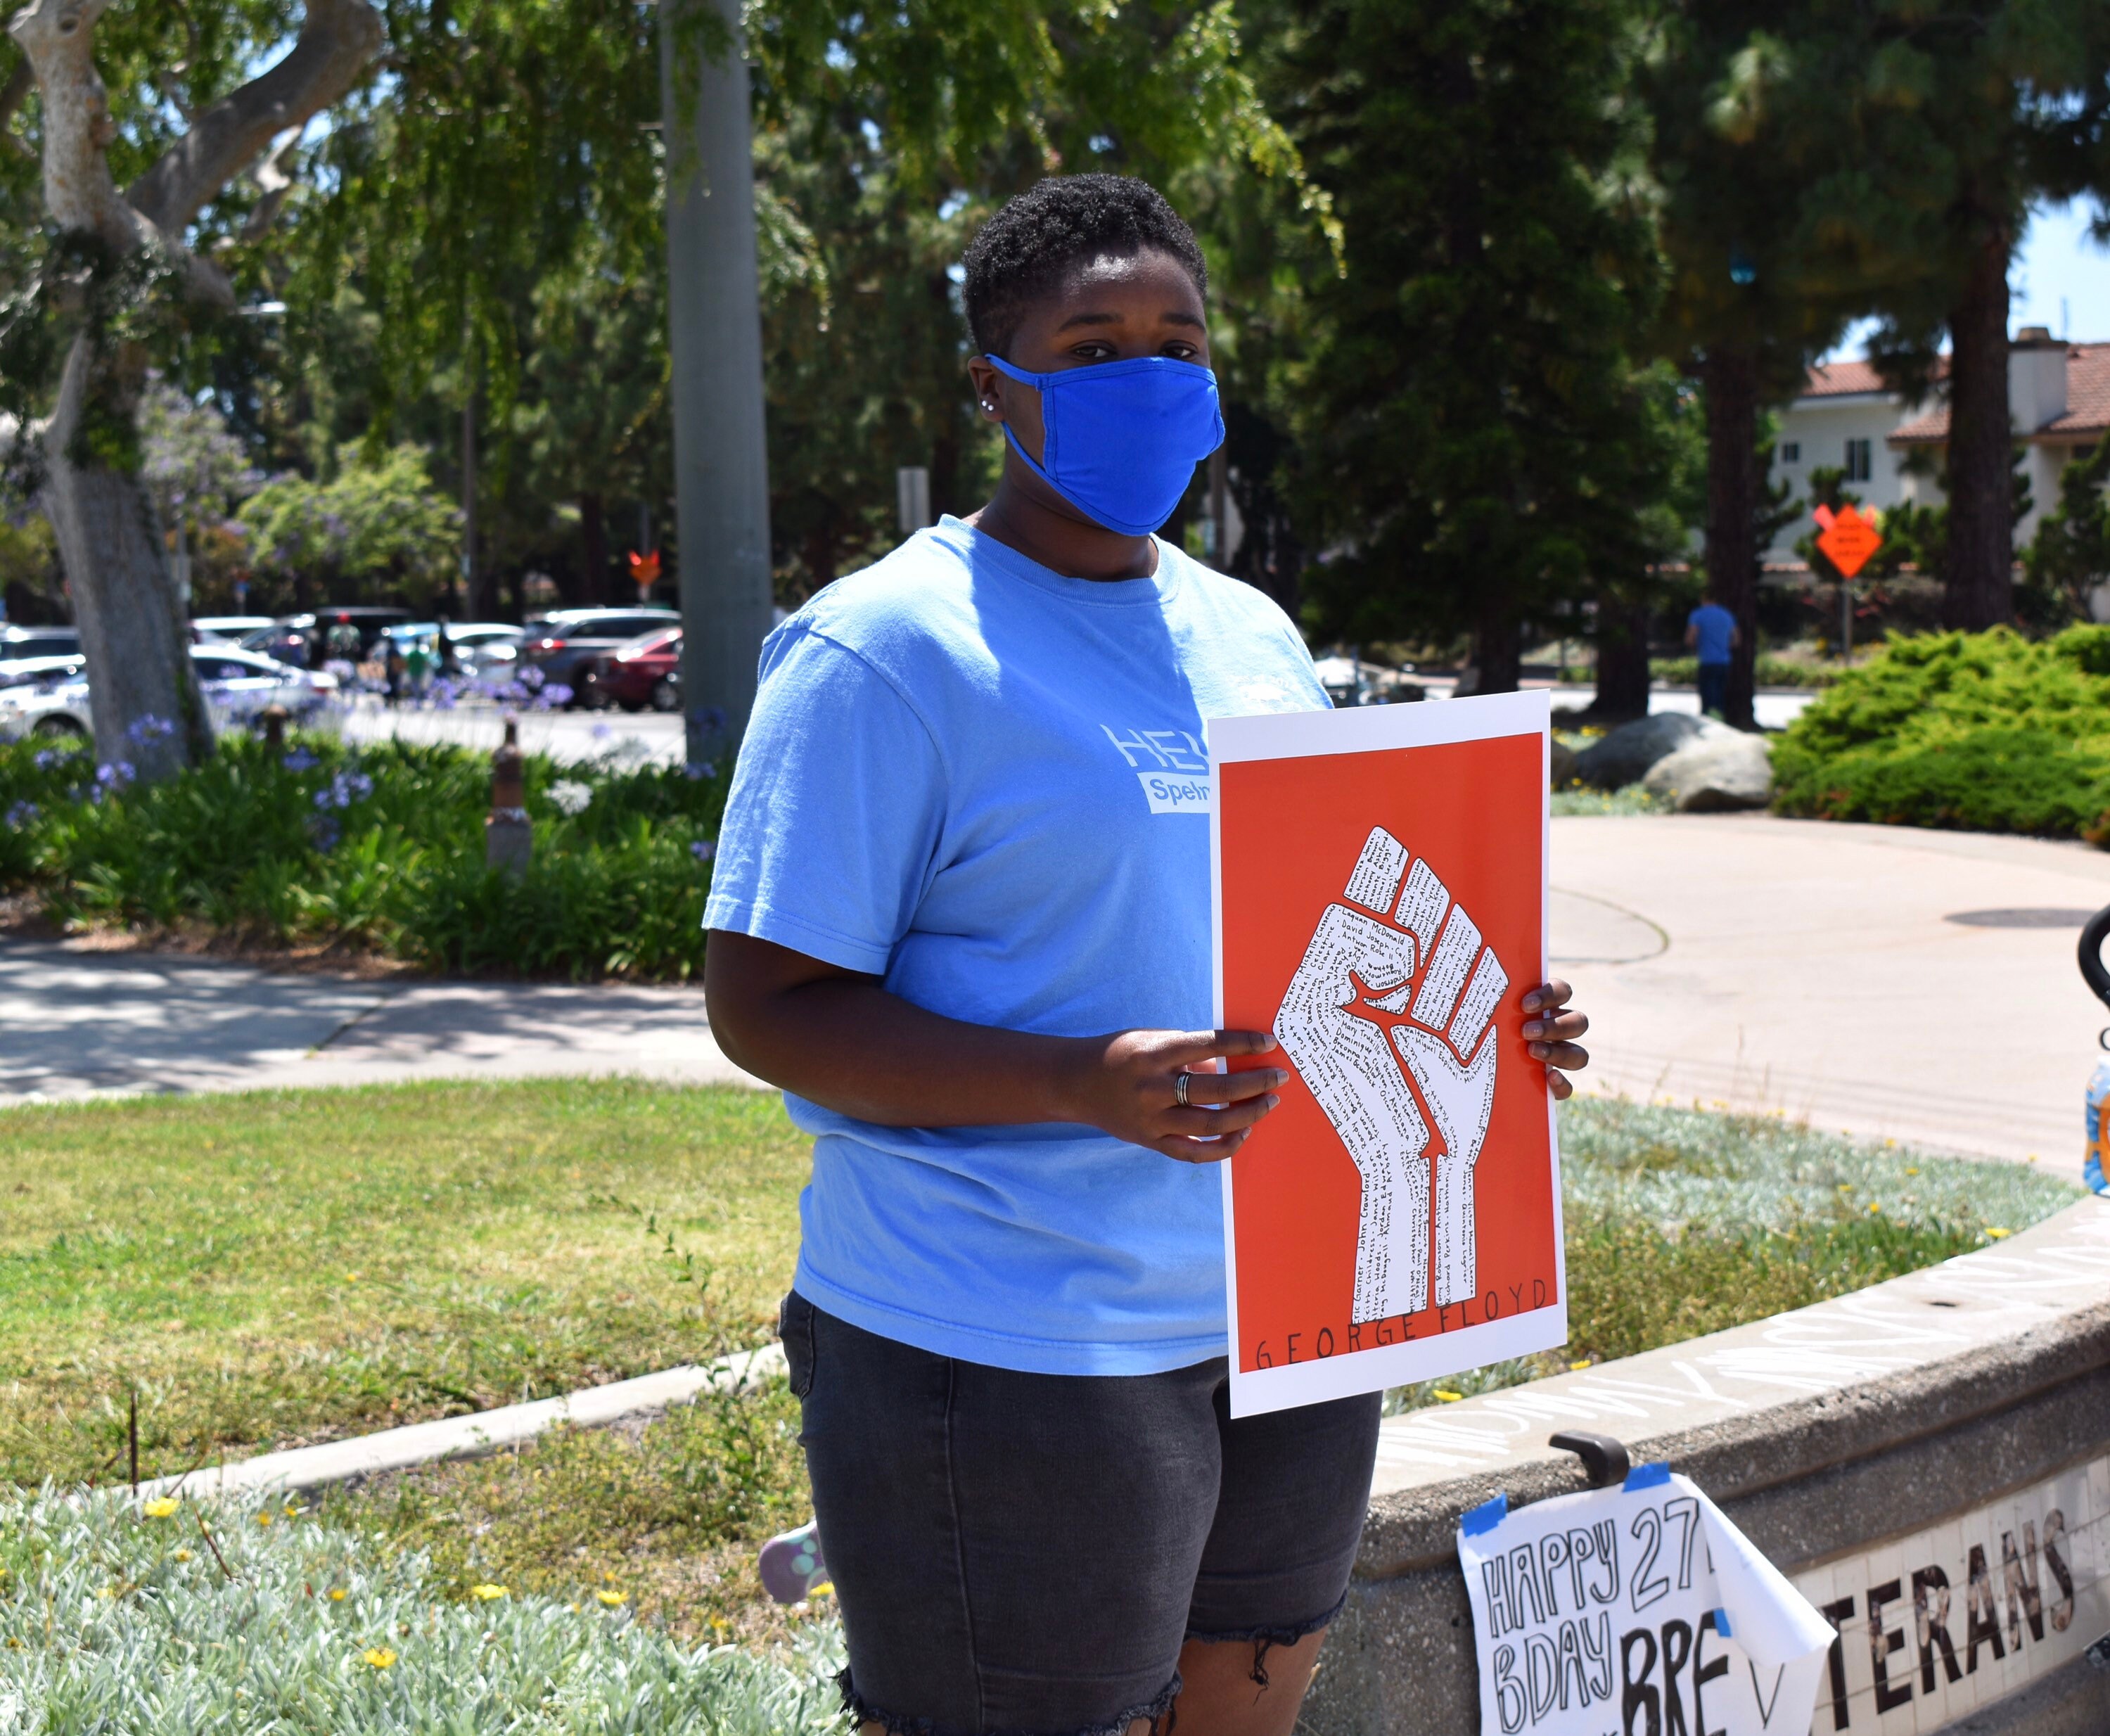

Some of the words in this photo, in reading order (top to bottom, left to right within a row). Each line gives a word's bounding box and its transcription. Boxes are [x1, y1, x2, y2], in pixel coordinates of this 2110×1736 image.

[1367, 842, 1379, 862] Brown
[1360, 872, 1375, 904] Anthony
[1374, 879, 1386, 910] Michael
[1396, 898, 1407, 919] Keith
[1414, 910, 1426, 933] Smith
[1342, 920, 1362, 934] David
[1343, 909, 1367, 925] Laquan
[1372, 923, 1405, 945] McDonald
[1282, 983, 1296, 1009] Parker
[1299, 940, 1317, 974] Michelle
[1305, 1073, 1321, 1096] Ezell
[1326, 1103, 1342, 1128] Brown
[1334, 1094, 1350, 1121] Nelson
[1341, 1130, 1363, 1166] Michael
[1257, 1313, 1416, 1370] GEORGE
[1440, 1279, 1545, 1334] FLOYD
[1481, 1519, 1618, 1638] HAPPY
[1631, 1497, 1714, 1611] 27
[1821, 1508, 2073, 1730] TERANS
[1493, 1611, 1612, 1734] BDAY
